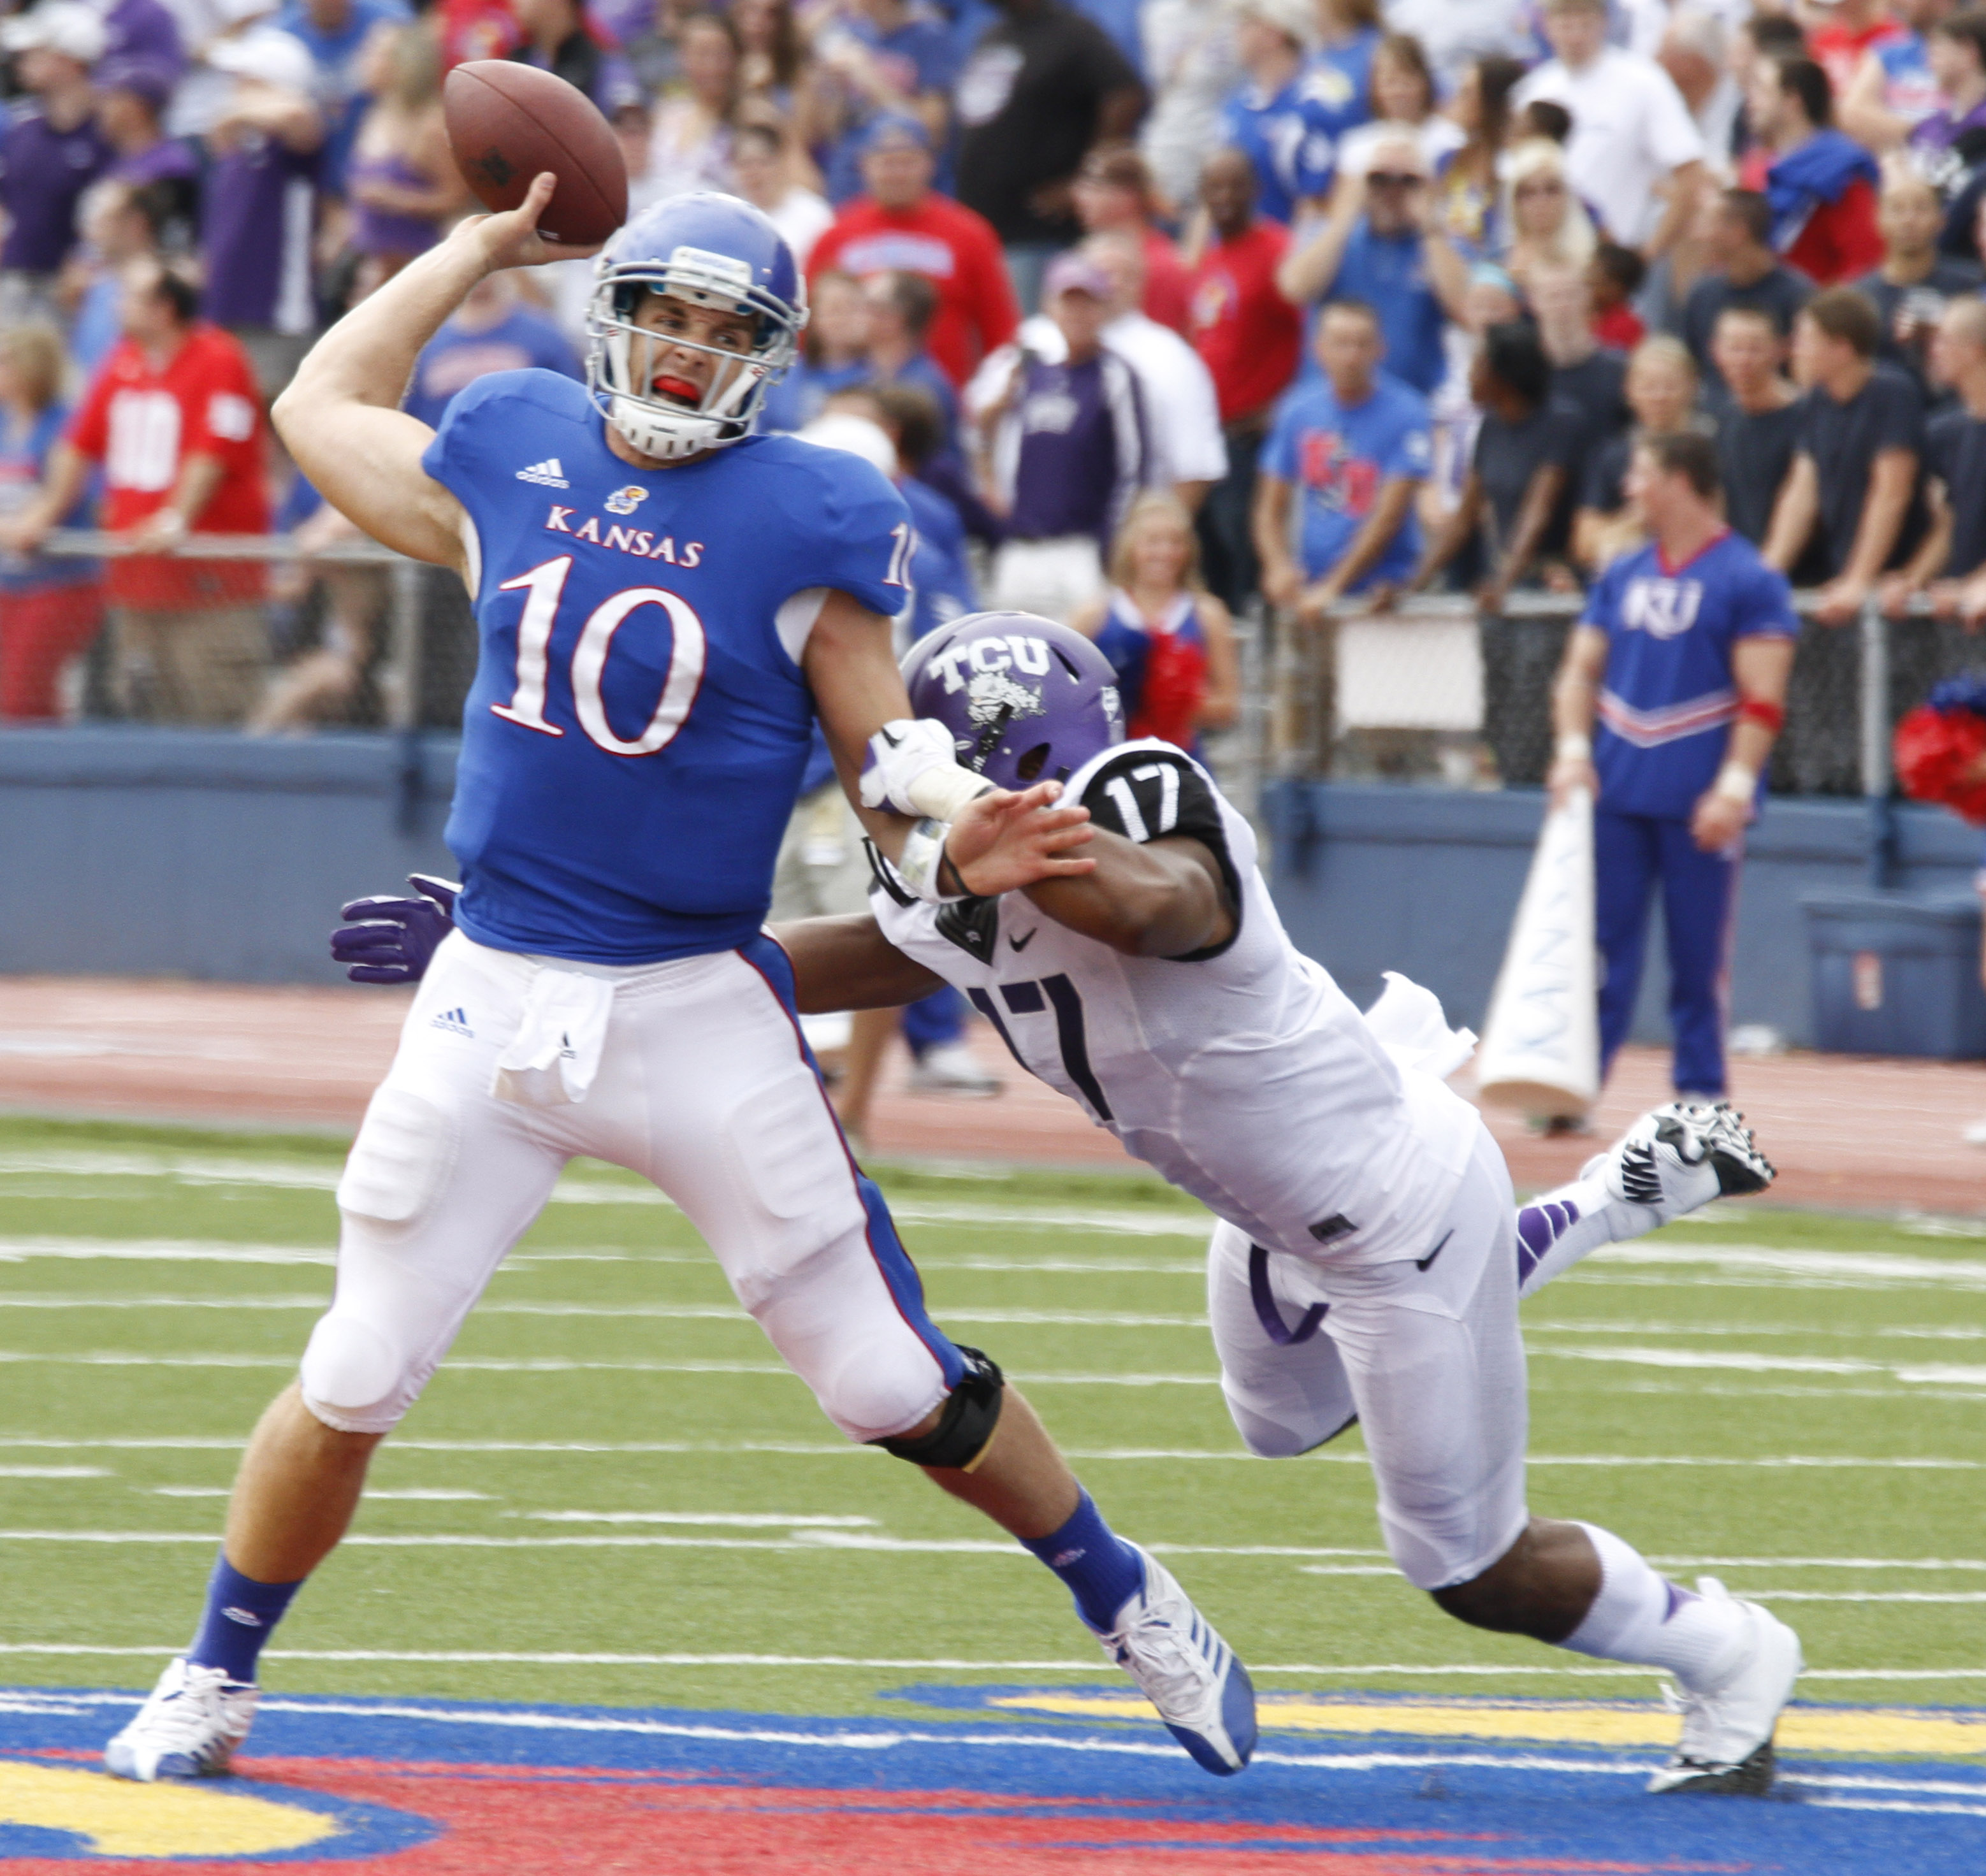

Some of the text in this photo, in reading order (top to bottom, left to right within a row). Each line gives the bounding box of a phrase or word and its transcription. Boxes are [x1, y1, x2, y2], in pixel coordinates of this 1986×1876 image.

[515, 471, 570, 489] adidas
[545, 504, 705, 568] KANSAS
[1623, 577, 1704, 640] KU
[489, 554, 708, 758] 10
[928, 635, 1052, 695] TCU
[1105, 763, 1180, 842] 17
[966, 973, 1114, 1122] 17
[1621, 1139, 1665, 1204] NIKE
